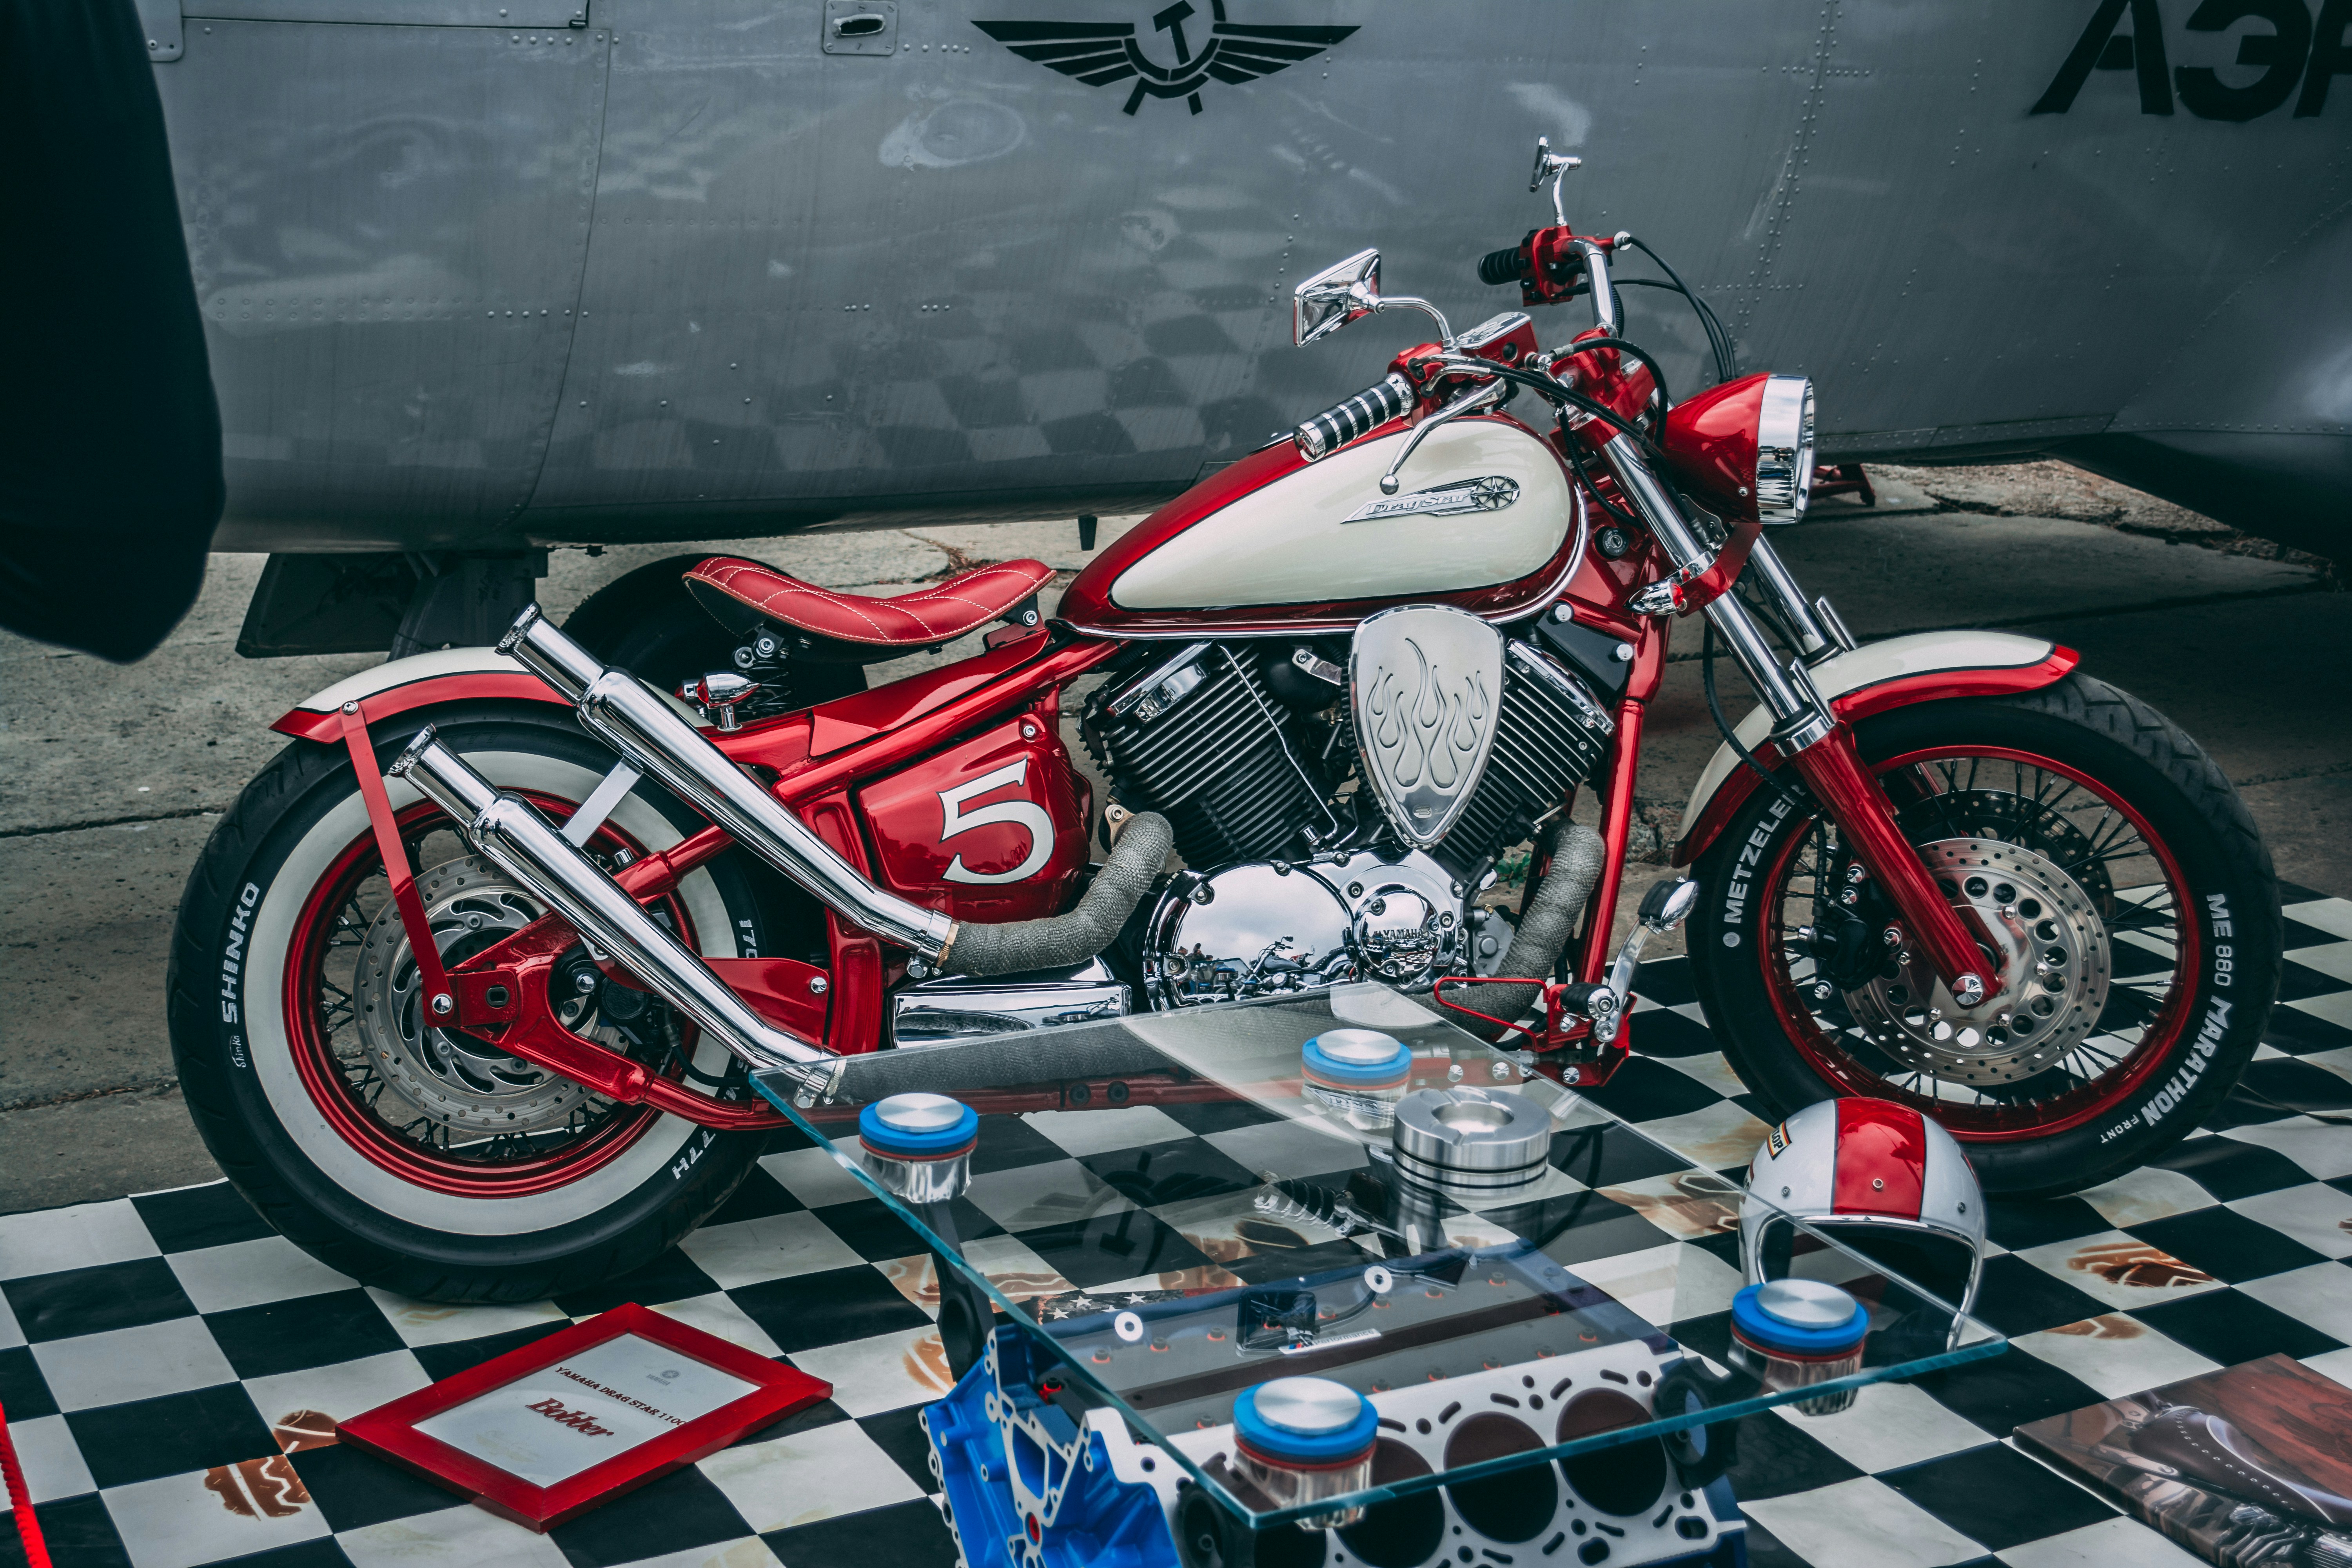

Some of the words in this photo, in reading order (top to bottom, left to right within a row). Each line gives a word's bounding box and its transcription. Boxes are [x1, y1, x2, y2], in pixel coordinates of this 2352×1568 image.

[936, 755, 1055, 885] 5
[1383, 928, 1424, 940] YAMAHA
[2206, 894, 2232, 938] ME
[221, 882, 260, 1024] SHINKO
[2214, 945, 2232, 986] 880
[2140, 995, 2232, 1127] MARATHON
[2100, 1114, 2140, 1143] FRONT
[671, 1131, 716, 1180] 77H
[555, 1367, 601, 1390] YAMAHA
[598, 1387, 632, 1403] DRAG
[628, 1399, 661, 1416] STAR
[645, 1374, 671, 1386] YAMAHA
[525, 1397, 615, 1437] Bobber
